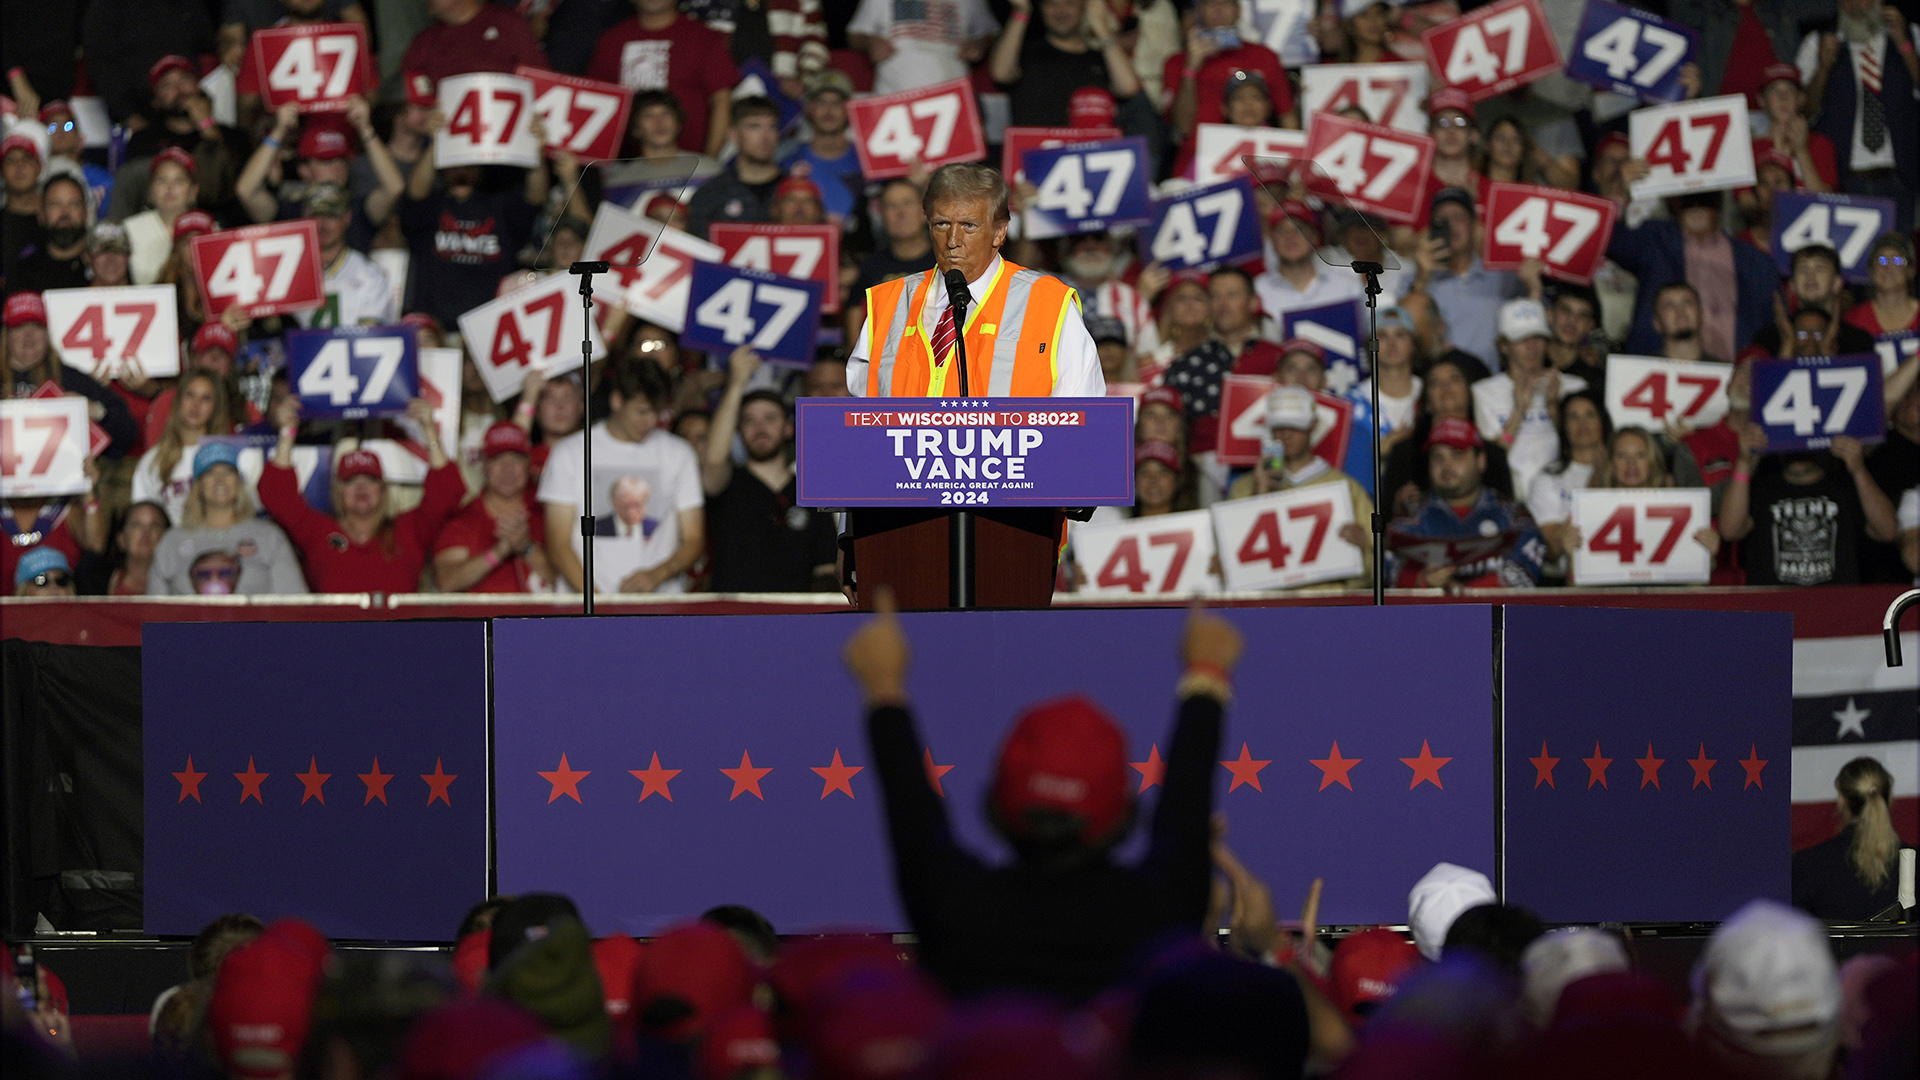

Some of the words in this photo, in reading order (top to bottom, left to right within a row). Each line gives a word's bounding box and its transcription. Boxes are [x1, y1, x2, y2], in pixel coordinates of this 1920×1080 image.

[269, 35, 358, 100] 47
[1446, 6, 1531, 84] 47
[1584, 17, 1688, 87] 47
[449, 88, 523, 144] 47
[535, 86, 621, 152] 47
[869, 94, 961, 162] 47
[1646, 114, 1731, 174] 47
[1038, 150, 1136, 218] 47
[1312, 132, 1419, 200] 47
[1151, 188, 1244, 265] 47
[1495, 198, 1601, 264] 47
[1782, 204, 1882, 268] 47
[209, 235, 306, 306] 47
[601, 233, 693, 300] 47
[63, 303, 156, 359] 47
[491, 292, 564, 367] 47
[696, 278, 809, 350] 47
[299, 337, 405, 406] 47
[1623, 371, 1721, 418] 47
[1762, 367, 1868, 436] 47
[850, 413, 893, 425] TEXT
[898, 413, 996, 425] WISCONSIN
[1001, 413, 1023, 425] TO
[1027, 413, 1080, 425] 88022
[886, 428, 1044, 456] TRUMP
[904, 457, 1026, 480] VANCE
[941, 491, 989, 504] 2024
[1237, 501, 1333, 570] 47
[1589, 505, 1693, 565] 47
[1770, 500, 1838, 522] TRUMP
[1097, 530, 1194, 592] 47
